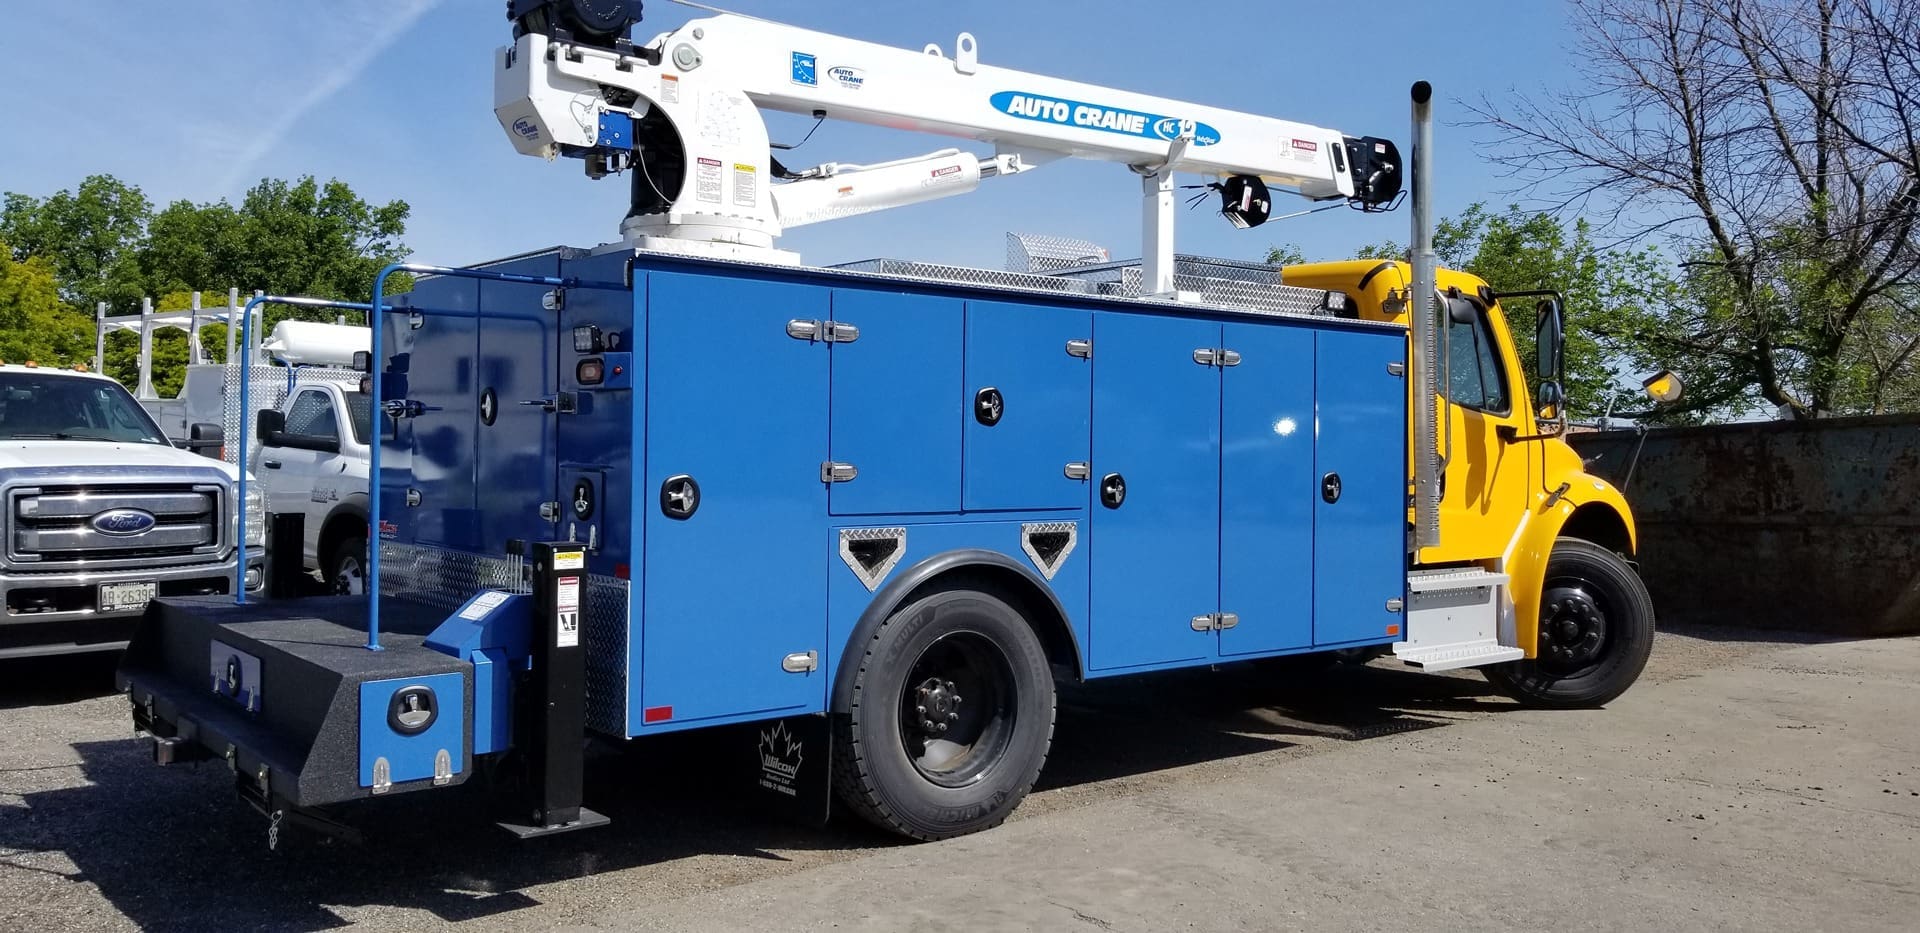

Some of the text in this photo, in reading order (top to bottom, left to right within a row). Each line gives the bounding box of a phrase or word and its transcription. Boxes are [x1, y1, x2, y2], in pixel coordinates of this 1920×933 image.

[834, 68, 854, 76] AUTO
[838, 75, 864, 84] CRANE
[1007, 95, 1069, 123] AUTO
[1073, 106, 1144, 134] CRANE
[1162, 121, 1175, 134] HC
[108, 512, 143, 528] Ford
